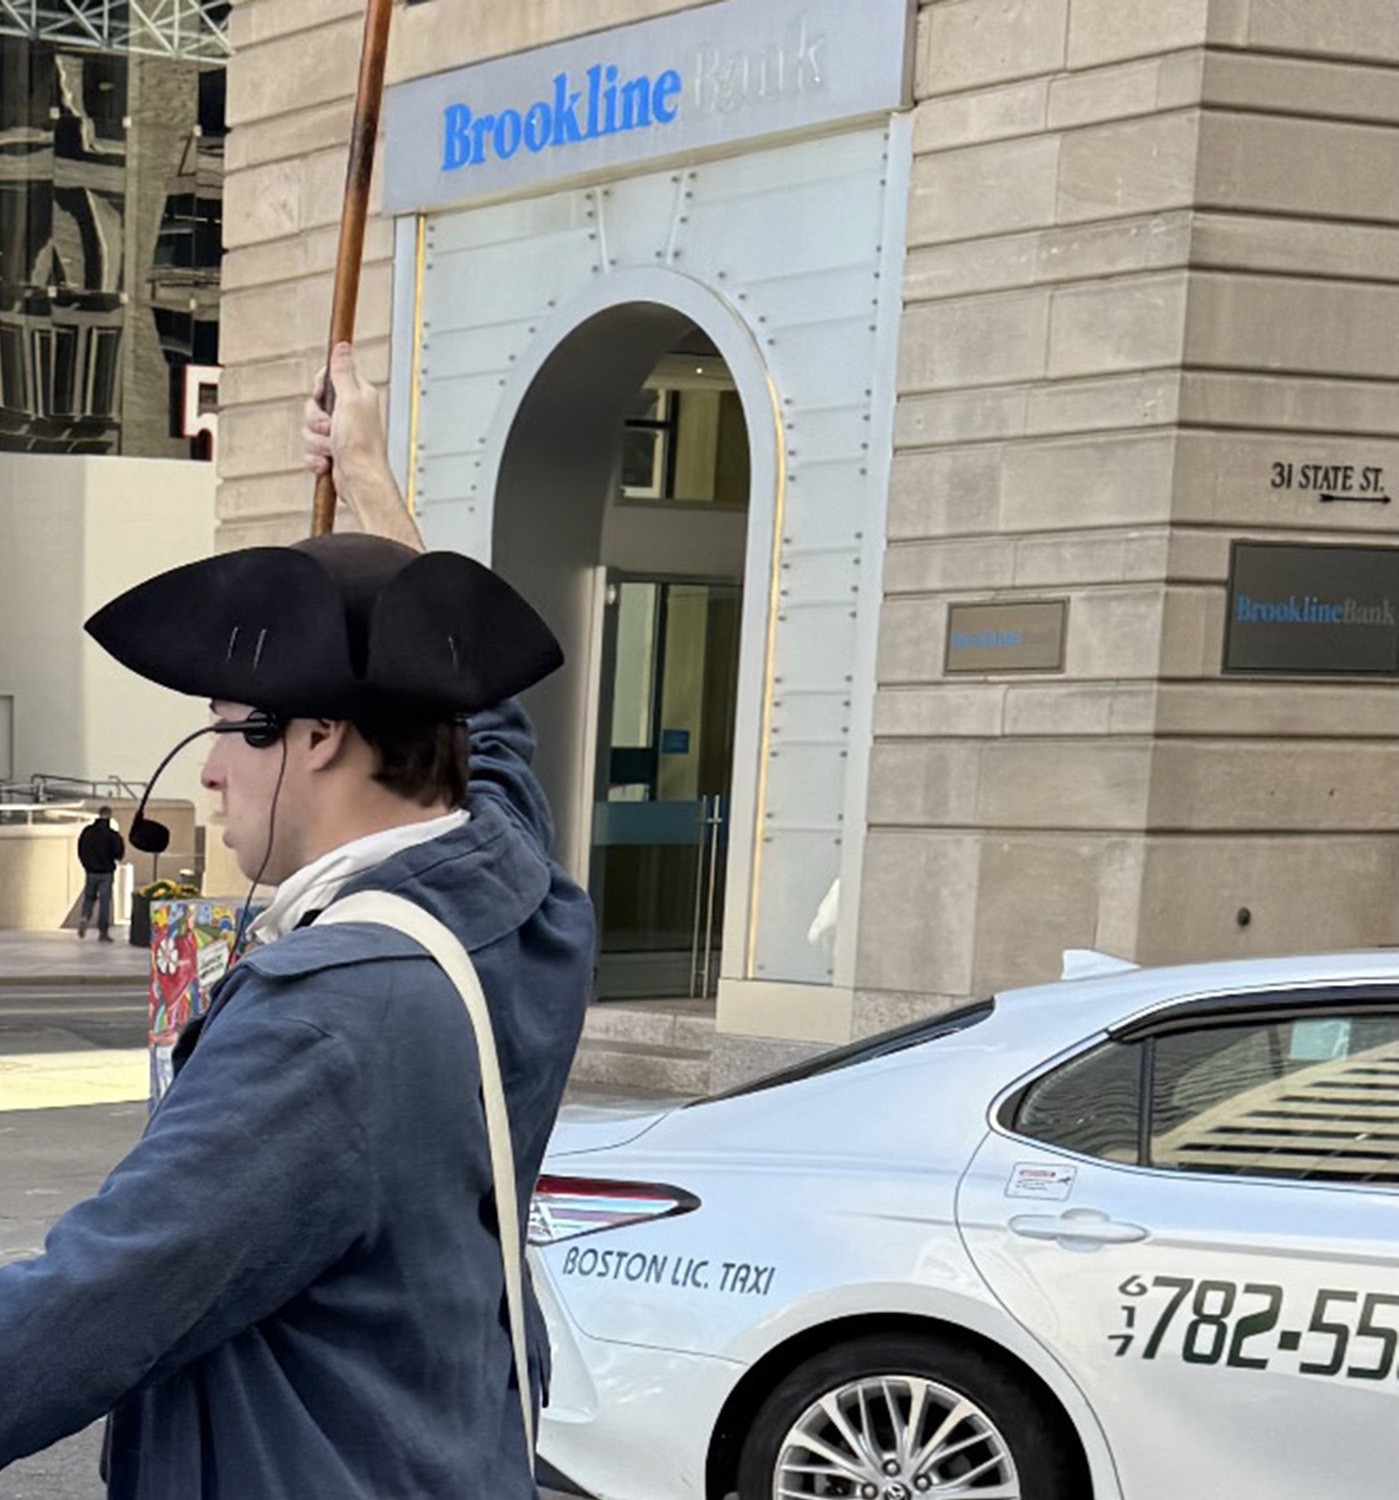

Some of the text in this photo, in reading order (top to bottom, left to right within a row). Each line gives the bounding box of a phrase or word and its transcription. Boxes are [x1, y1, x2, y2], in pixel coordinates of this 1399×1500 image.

[441, 64, 682, 170] Brookline
[1270, 461, 1384, 493] 31 STATE ST.
[563, 1246, 776, 1297] BOSTON LIC. TAXI
